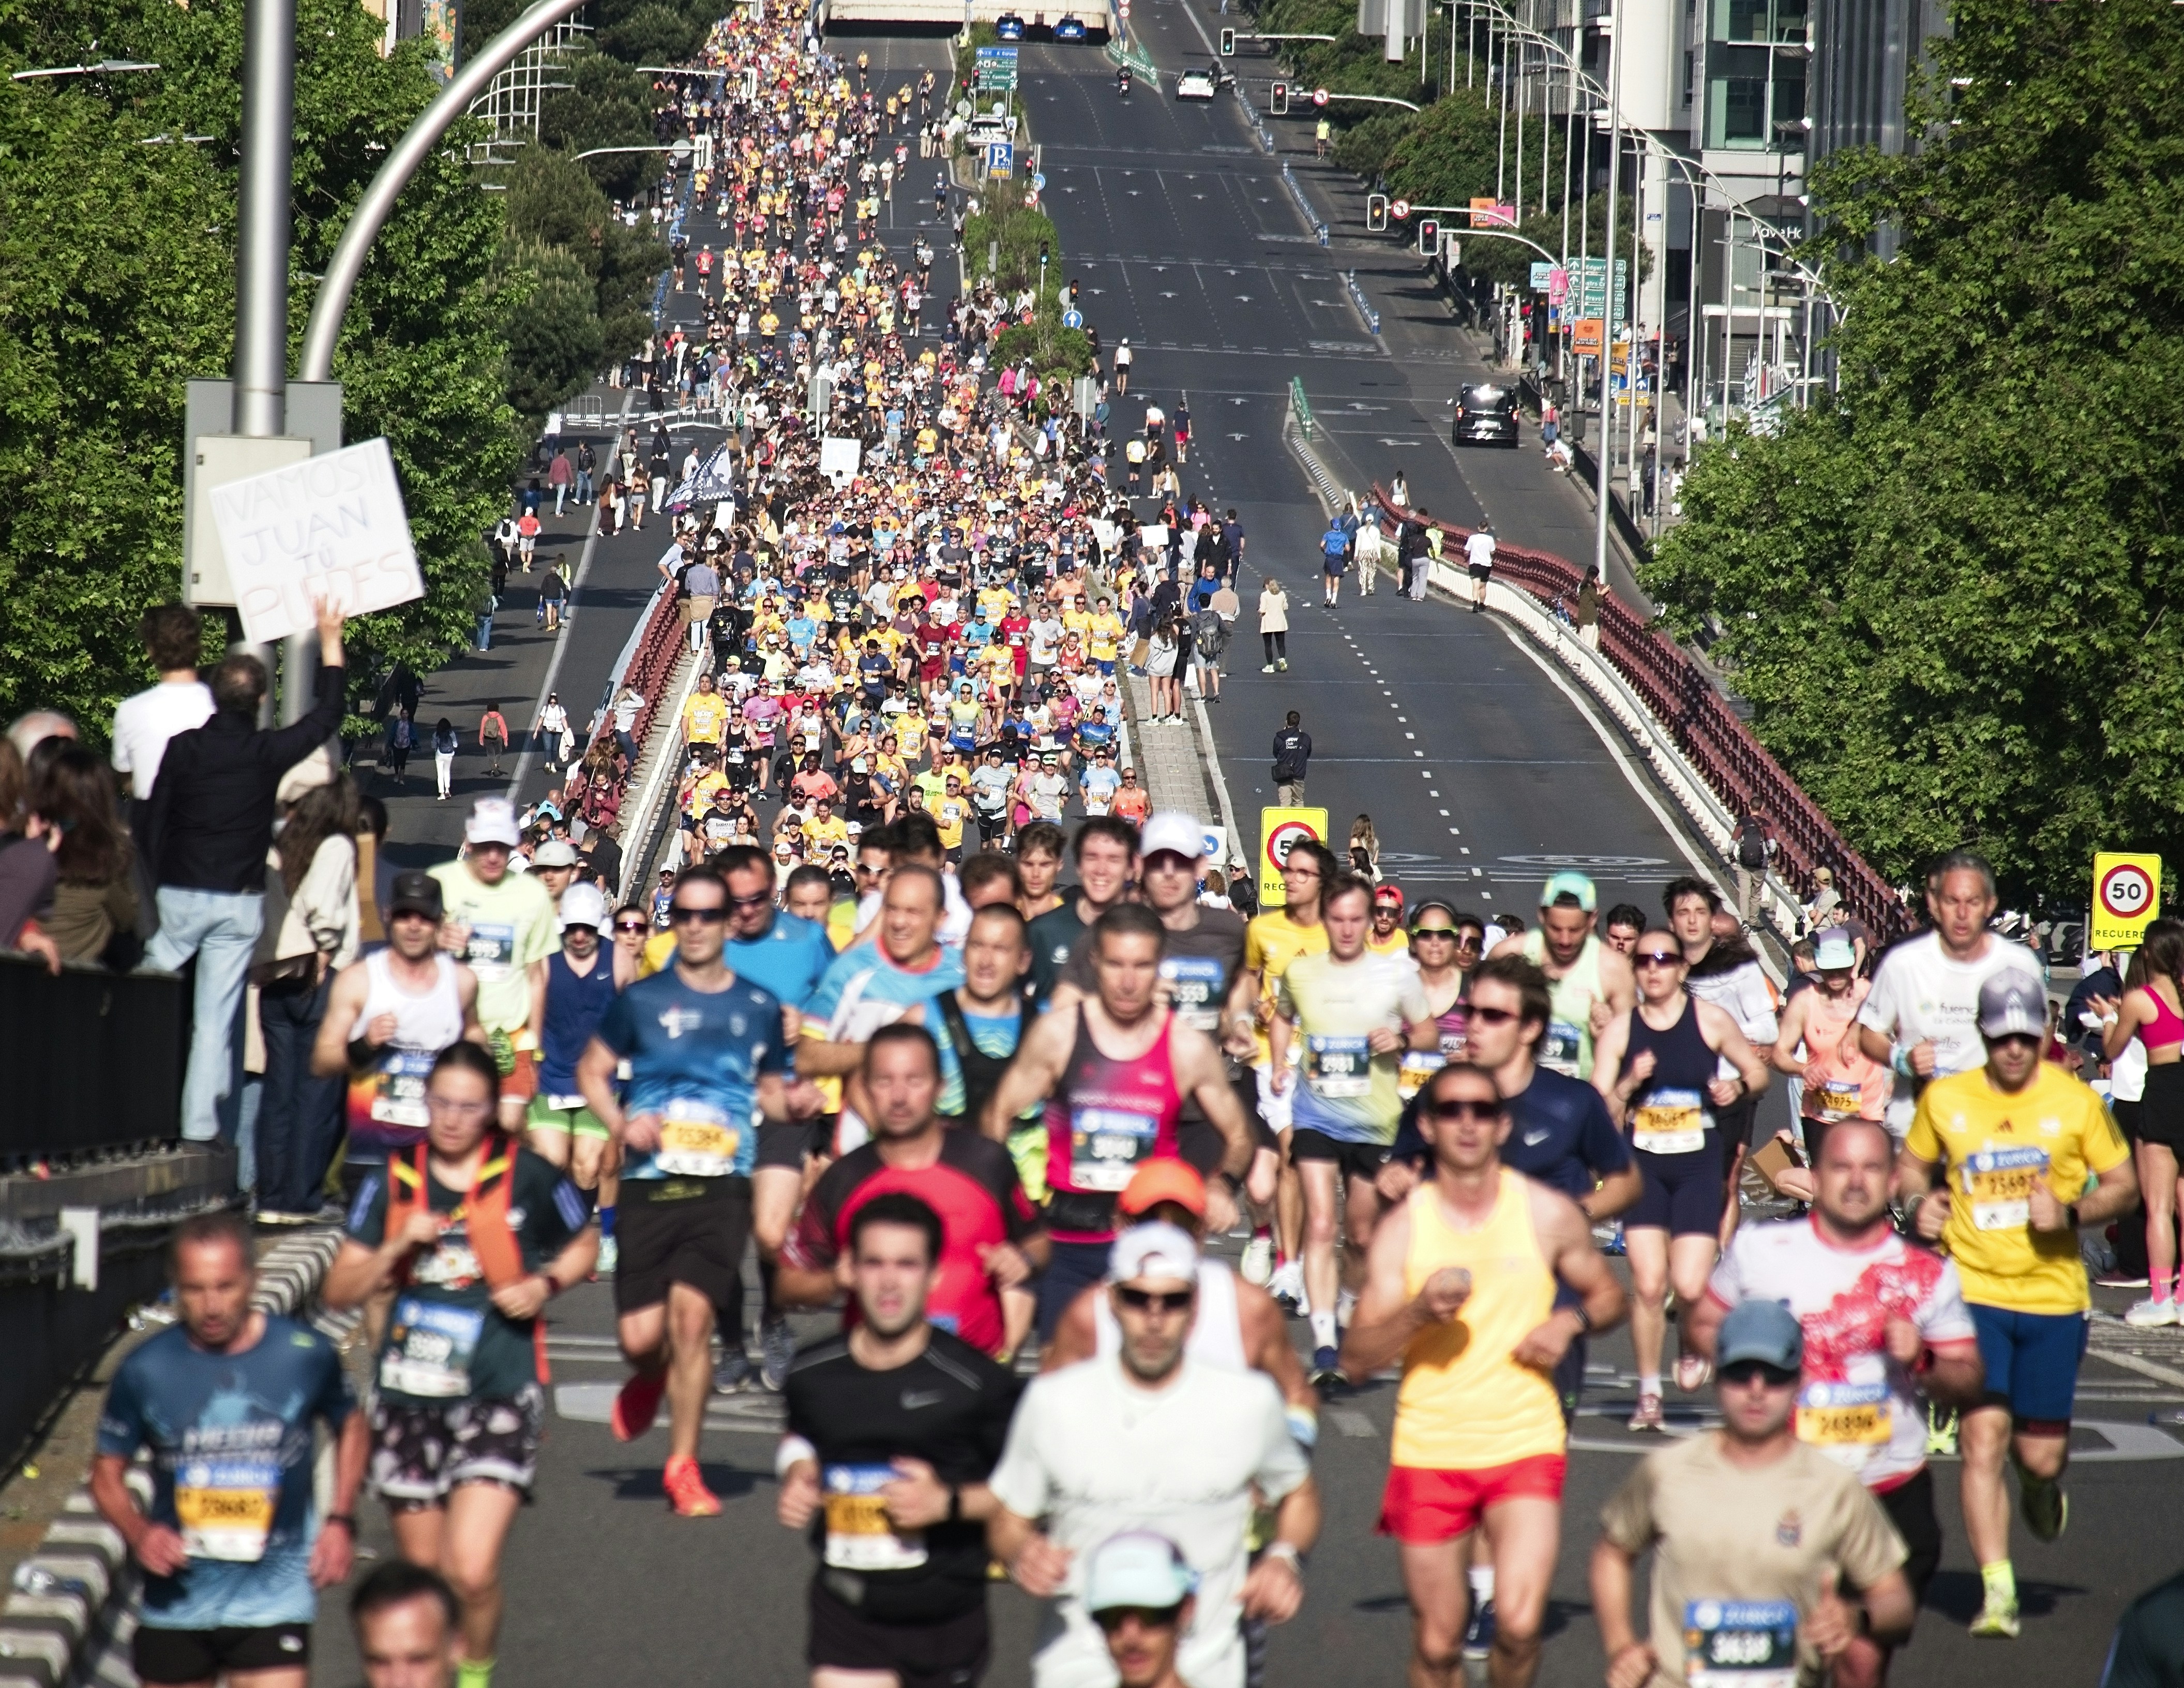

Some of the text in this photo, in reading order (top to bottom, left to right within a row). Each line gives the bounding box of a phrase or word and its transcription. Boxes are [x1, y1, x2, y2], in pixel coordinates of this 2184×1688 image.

[239, 495, 371, 566] JUAN
[2112, 883, 2141, 900] 50
[2095, 930, 2144, 939] RECUERD
[1329, 1040, 1367, 1050] ZURICH
